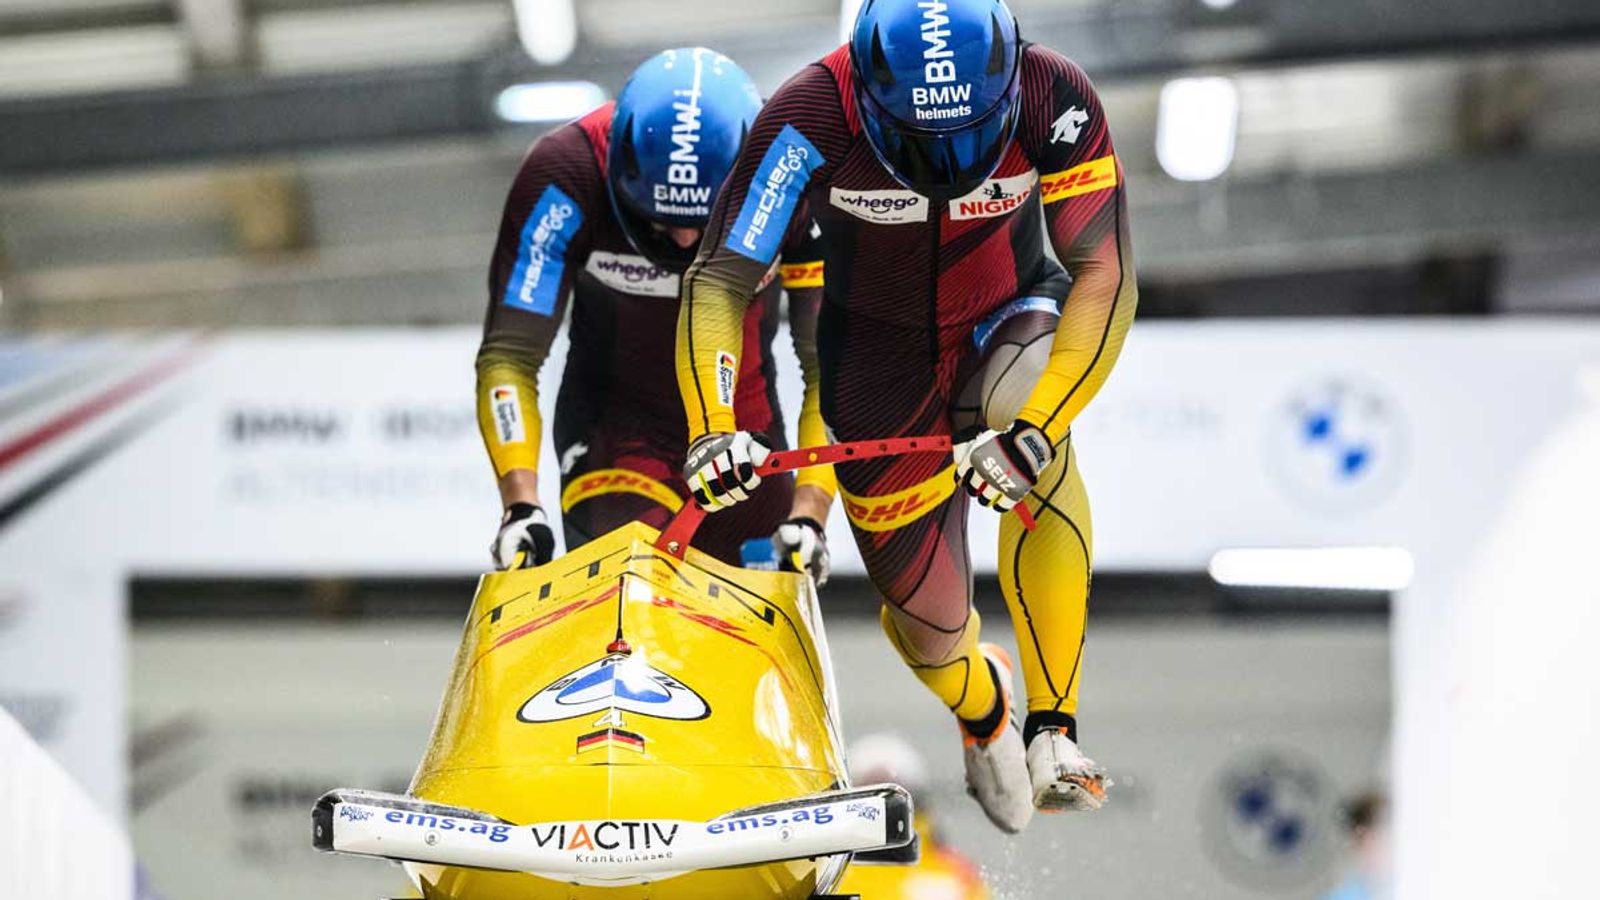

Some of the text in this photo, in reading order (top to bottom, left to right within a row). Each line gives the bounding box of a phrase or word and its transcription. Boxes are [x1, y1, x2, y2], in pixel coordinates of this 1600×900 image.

[917, 2, 956, 83] BMW
[912, 84, 972, 105] BMW
[916, 105, 972, 120] helmets
[668, 101, 702, 185] BMW
[654, 184, 711, 203] BMW
[1041, 169, 1098, 195] DHL
[655, 201, 709, 216] helmets
[840, 195, 919, 212] wheego
[597, 260, 671, 281] wheego
[982, 456, 1017, 493] SEIZ
[850, 494, 927, 522] DHL
[592, 708, 627, 728] 4
[385, 810, 512, 843] ems.ag
[706, 804, 834, 835] ems.ag
[531, 821, 679, 850] VIACTIV
